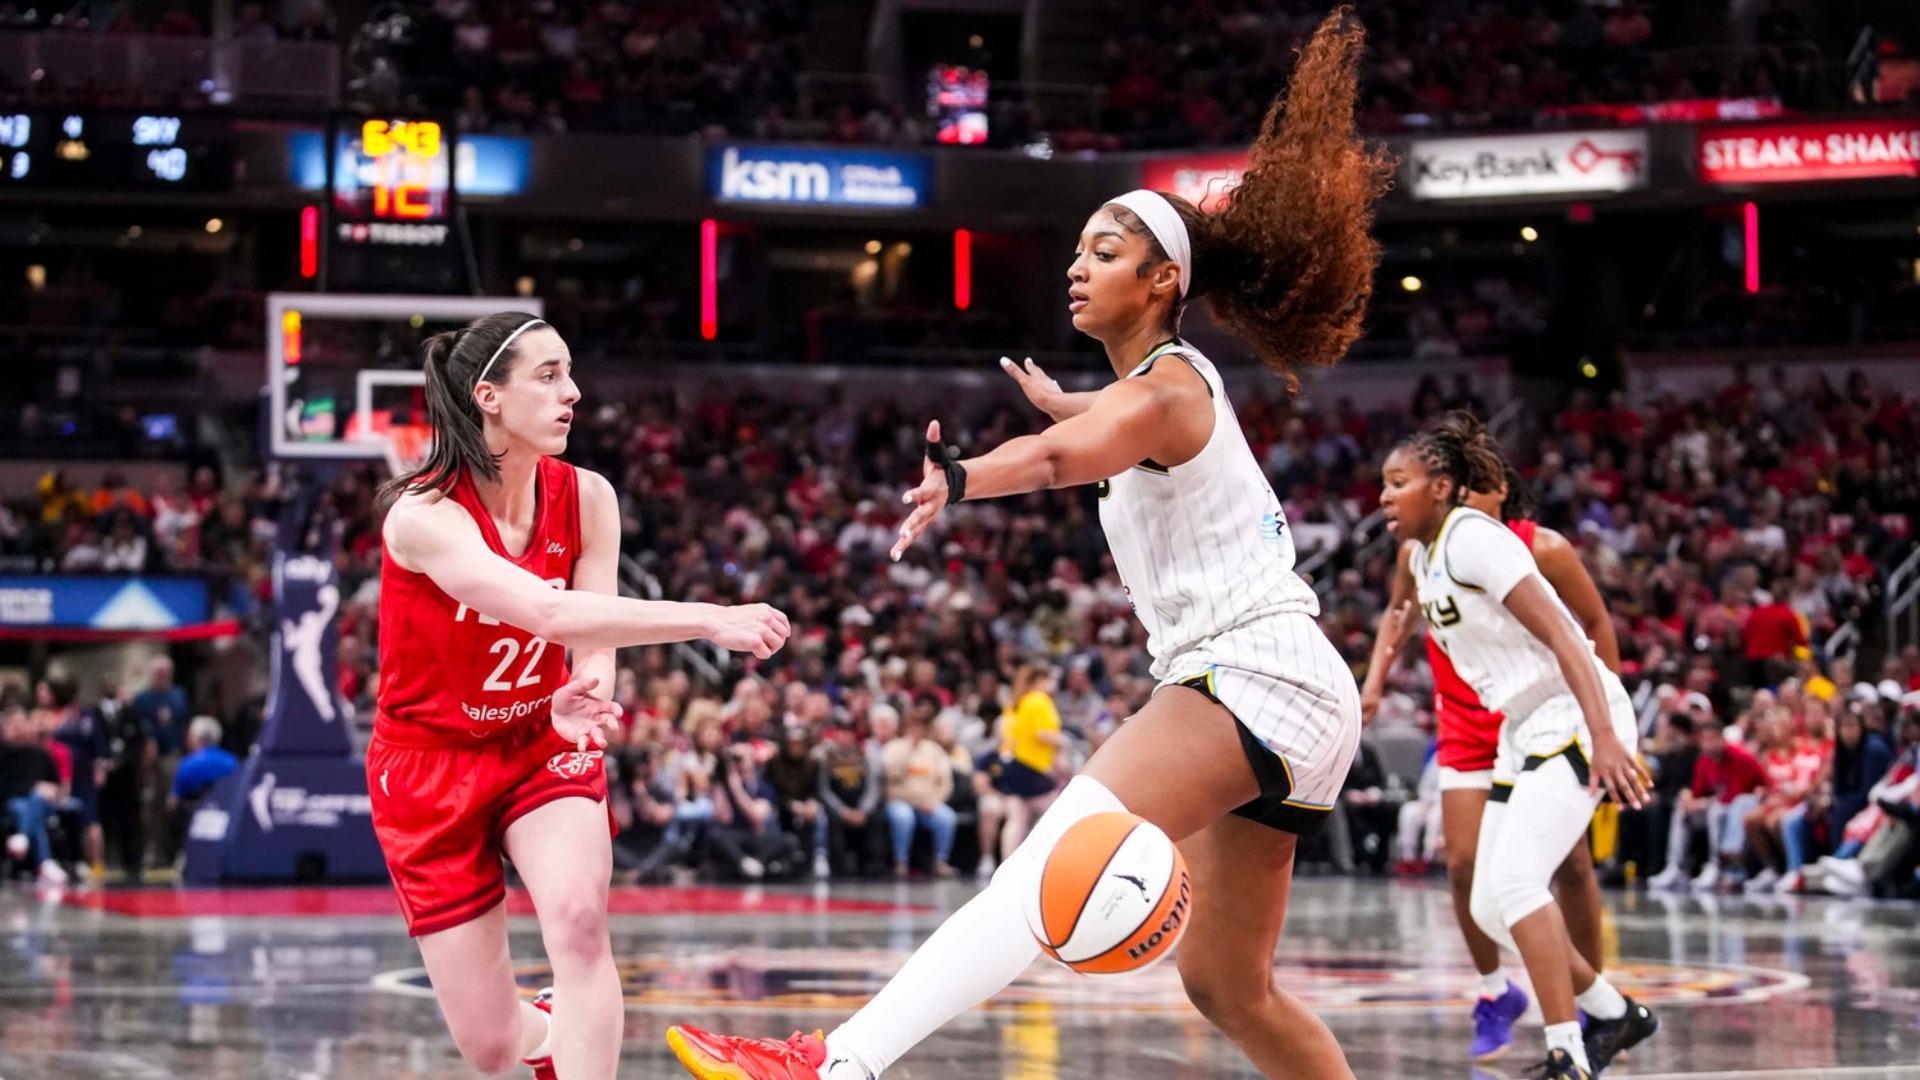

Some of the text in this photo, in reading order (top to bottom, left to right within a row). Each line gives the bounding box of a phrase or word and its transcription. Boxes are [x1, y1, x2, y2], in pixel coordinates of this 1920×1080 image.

[132, 115, 181, 145] SKY
[147, 147, 187, 181] 40
[1412, 150, 1559, 186] KeyBank
[1702, 136, 1802, 170] STEAK
[722, 147, 829, 201] ksm
[369, 222, 448, 245] TISSOT
[1422, 595, 1462, 629] KY
[482, 636, 548, 692] 22
